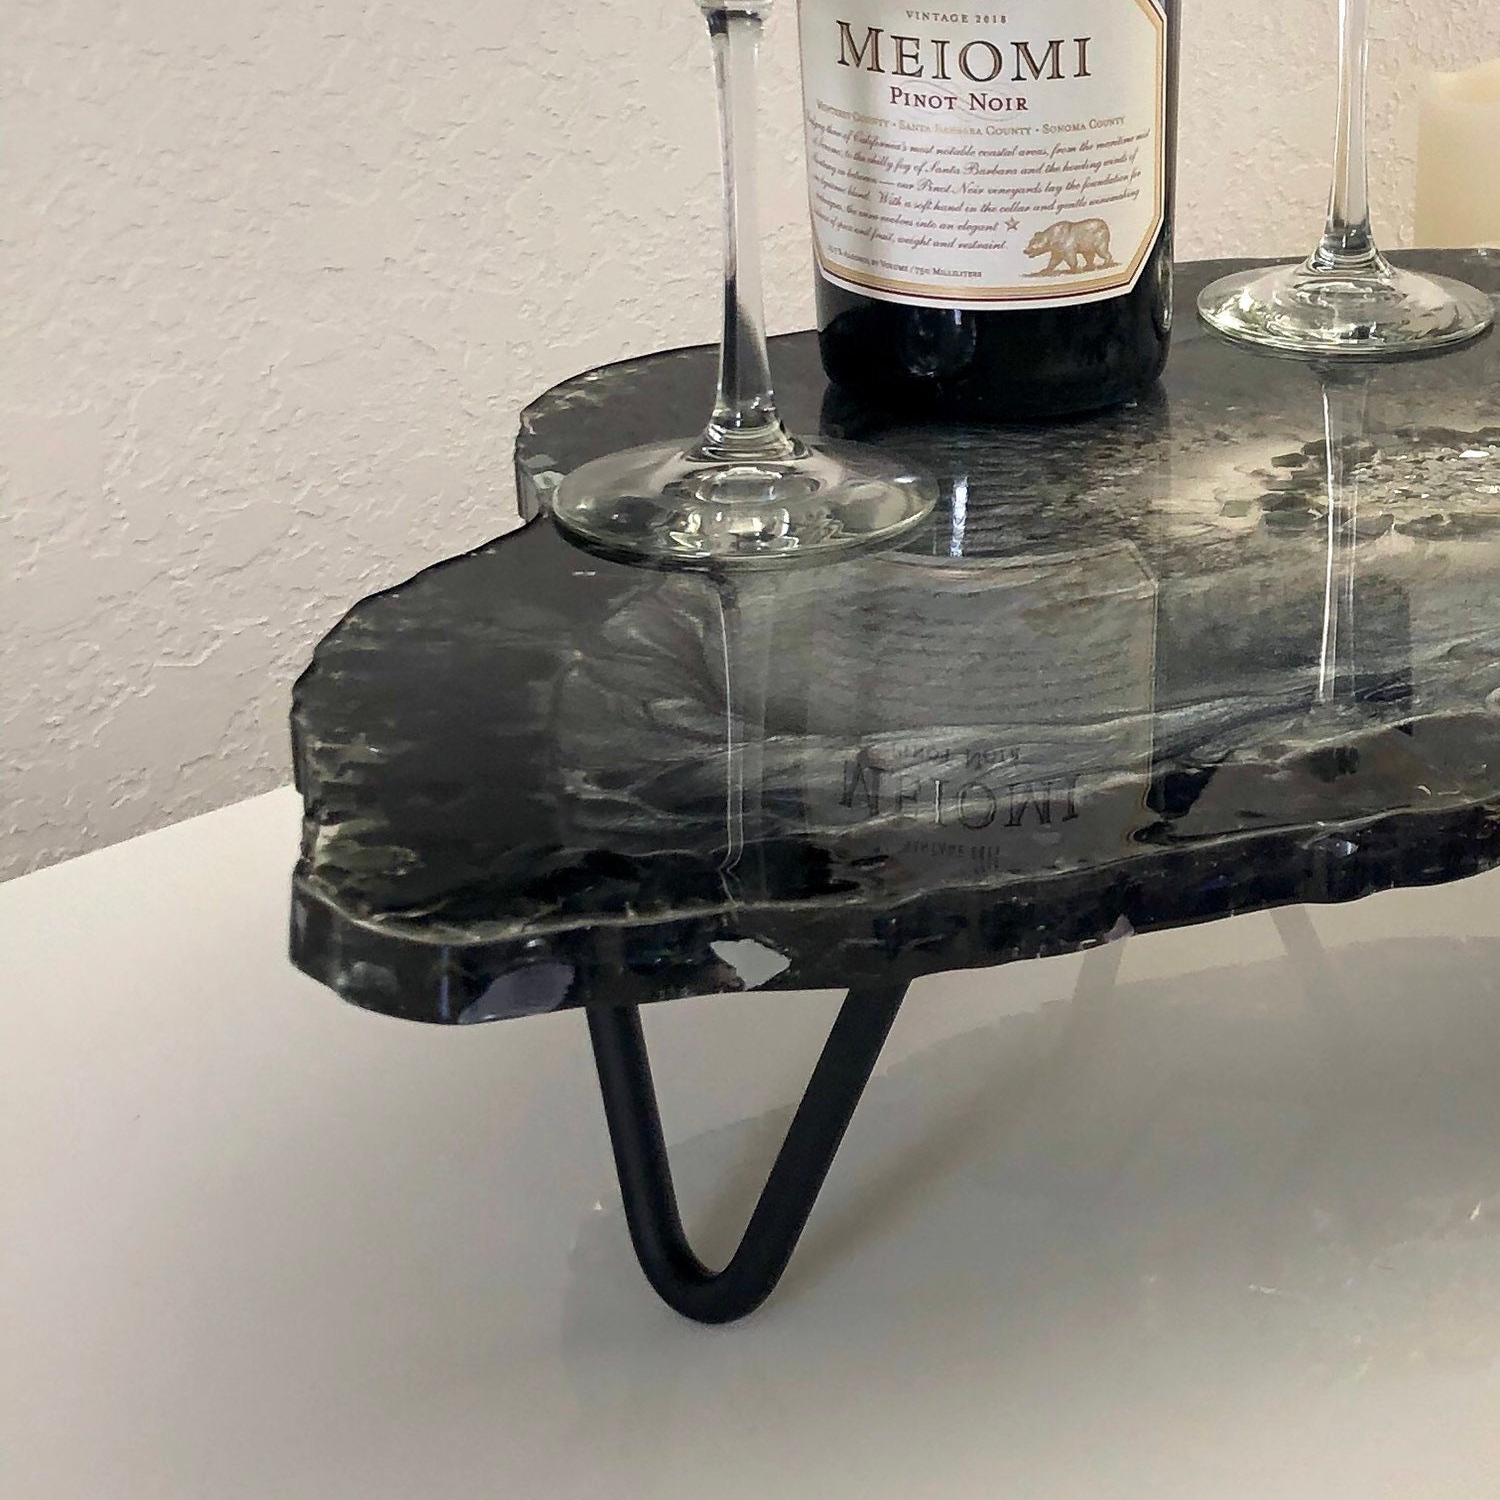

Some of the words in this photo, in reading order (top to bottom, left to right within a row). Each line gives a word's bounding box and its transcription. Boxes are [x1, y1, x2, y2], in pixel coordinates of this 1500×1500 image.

[905, 10, 969, 24] VINTAGE
[836, 19, 1092, 82] MEIOMI
[890, 86, 958, 110] PINOT
[969, 92, 1029, 112] NOIR
[936, 145, 976, 157] notable
[978, 145, 1019, 157] coastal
[1049, 142, 1077, 160] from
[963, 161, 1018, 176] Barbara
[1020, 162, 1045, 175] and
[1045, 161, 1061, 174] the
[933, 199, 965, 212] hand
[980, 201, 998, 213] the
[999, 201, 1031, 213] cellar
[1032, 199, 1058, 213] and
[957, 219, 1000, 237] elegant
[933, 237, 958, 249] and
